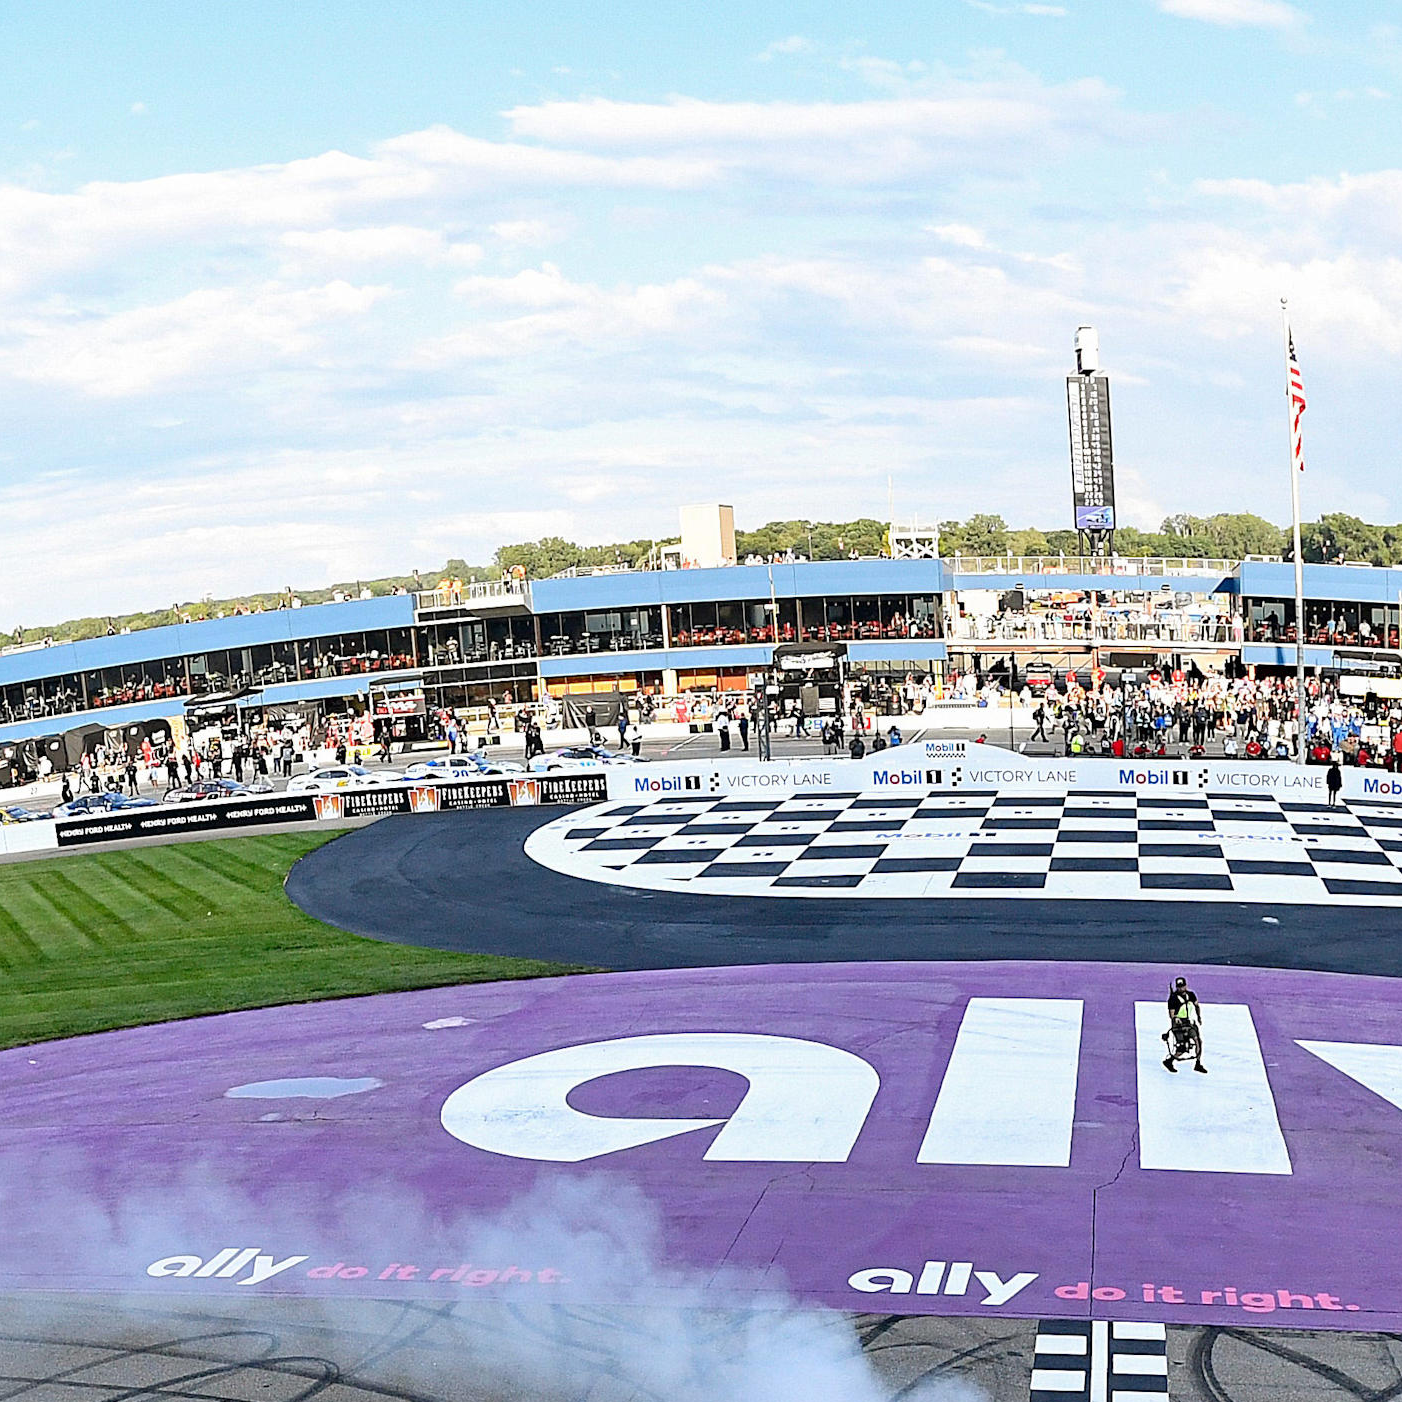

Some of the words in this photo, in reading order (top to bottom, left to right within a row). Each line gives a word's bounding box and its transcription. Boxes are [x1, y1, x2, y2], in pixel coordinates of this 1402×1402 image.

[925, 743, 954, 752] Mobil
[635, 776, 681, 792] Mobil
[727, 774, 789, 788] VICTORY
[793, 773, 832, 786] LANE
[873, 770, 922, 785] Mobil
[970, 770, 1033, 783] VICTORY
[1037, 770, 1077, 783] LANE
[1119, 769, 1168, 785] Mobil
[1216, 773, 1280, 787] VICTORY
[1284, 775, 1323, 789] LANE
[442, 785, 504, 800] FIREKEEPERS
[543, 779, 605, 794] FIREKEEPERS
[345, 792, 405, 809] FIREKEEPERS
[226, 808, 253, 819] HENRY
[254, 806, 275, 816] FORD
[275, 804, 307, 814] HEALTH
[167, 816, 186, 826] FORD
[187, 813, 217, 823] HEALTH
[84, 826, 103, 835] FORD
[104, 823, 133, 833] HEALTH
[1198, 833, 1283, 841] Mobil
[145, 1248, 309, 1285] ally
[306, 1262, 369, 1280] do
[376, 1262, 421, 1281] it
[428, 1264, 573, 1287] right.
[847, 1260, 1040, 1306] ally
[1054, 1281, 1126, 1301] do
[1142, 1283, 1186, 1304] it
[1200, 1286, 1361, 1313] right.
